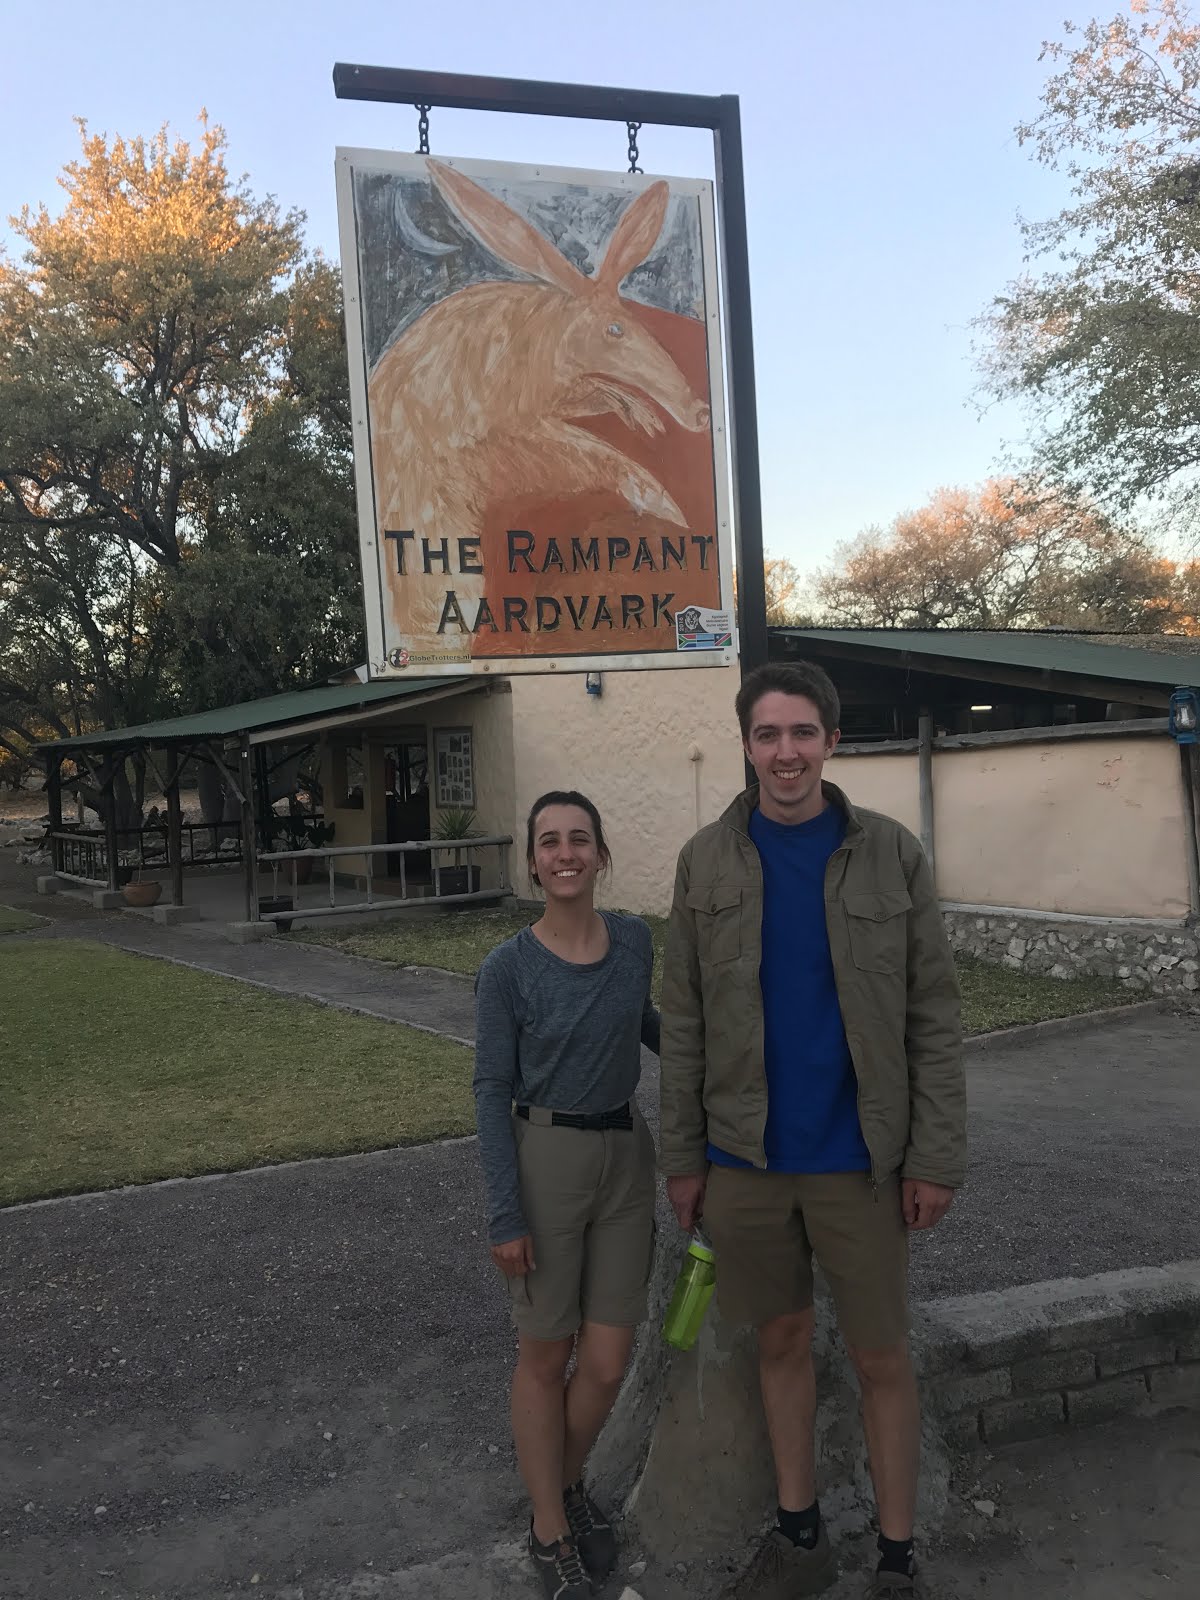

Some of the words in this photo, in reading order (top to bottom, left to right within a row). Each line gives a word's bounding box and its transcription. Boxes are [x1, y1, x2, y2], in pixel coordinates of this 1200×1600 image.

[384, 530, 484, 575] THE
[507, 529, 714, 573] RAMPANT
[436, 590, 676, 634] AARDVARK
